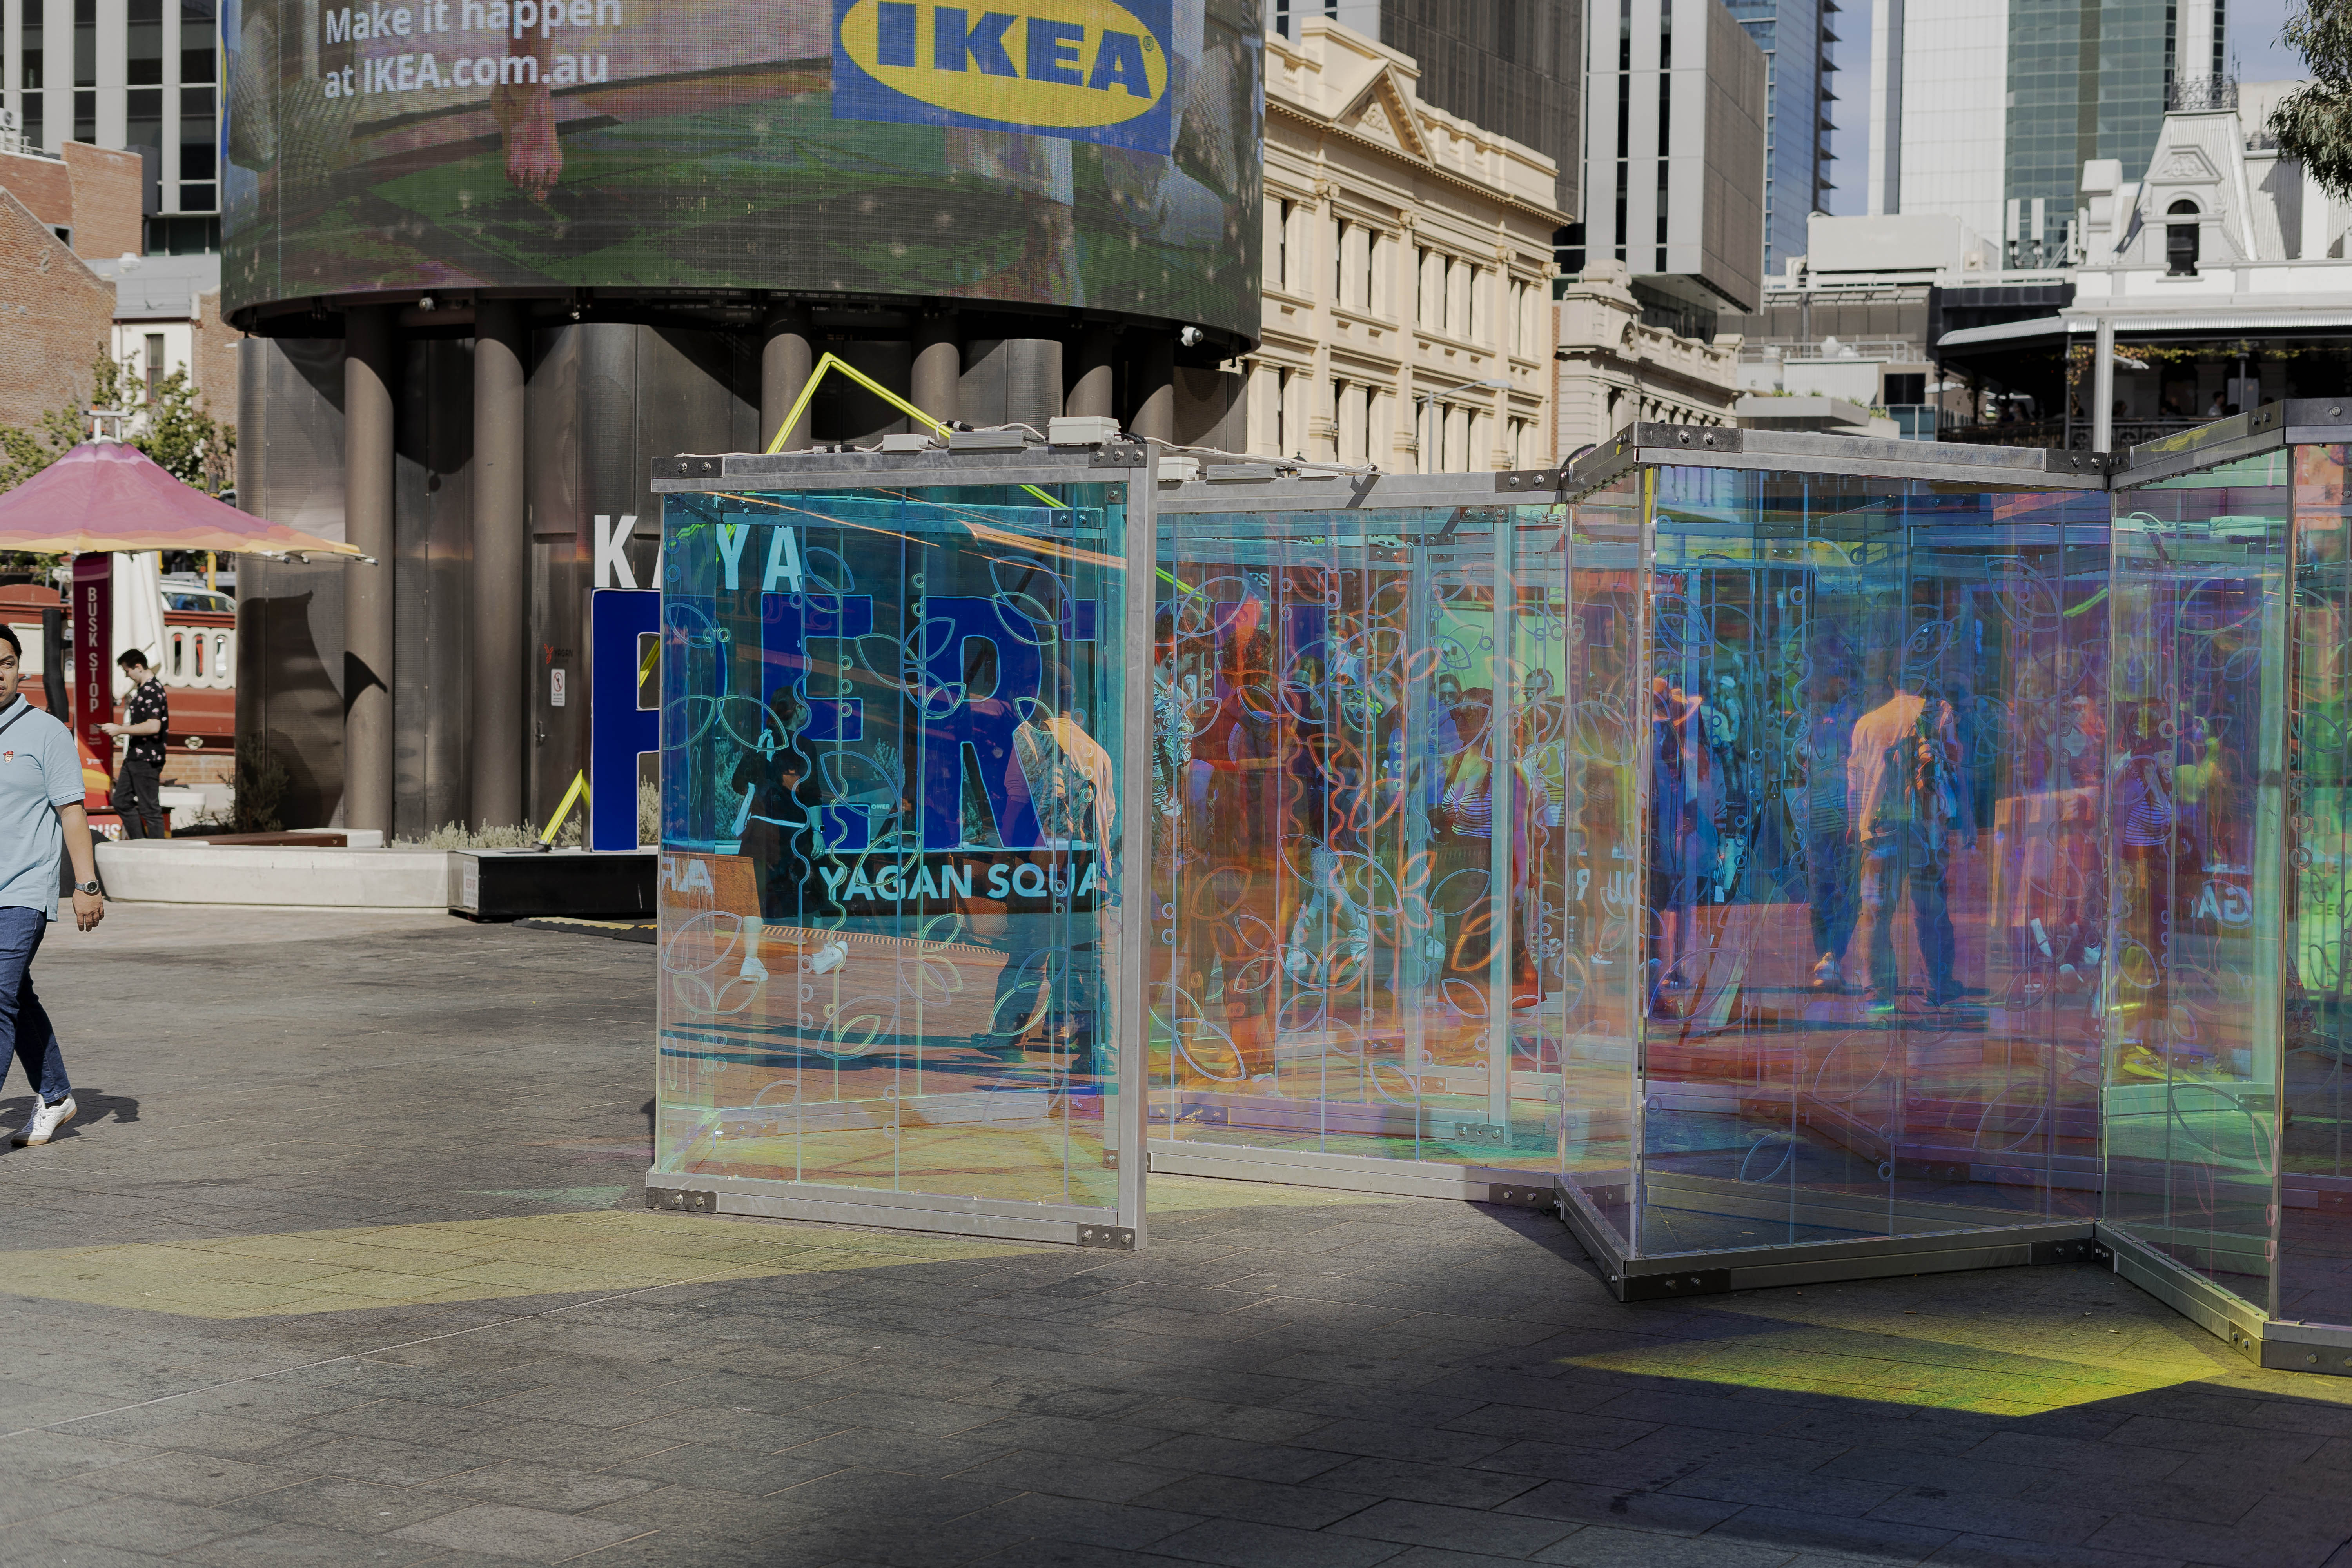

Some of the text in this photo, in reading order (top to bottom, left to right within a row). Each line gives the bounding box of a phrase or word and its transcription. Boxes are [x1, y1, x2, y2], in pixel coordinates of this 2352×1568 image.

[326, 0, 621, 44] Make it happen
[877, 1, 1152, 99] IKEA
[325, 52, 608, 98] at IKEA.com.au
[595, 515, 801, 592] KYA
[87, 587, 99, 713] BUSK STOP
[554, 649, 573, 657] YAGAN
[819, 864, 972, 901] YAGAN
